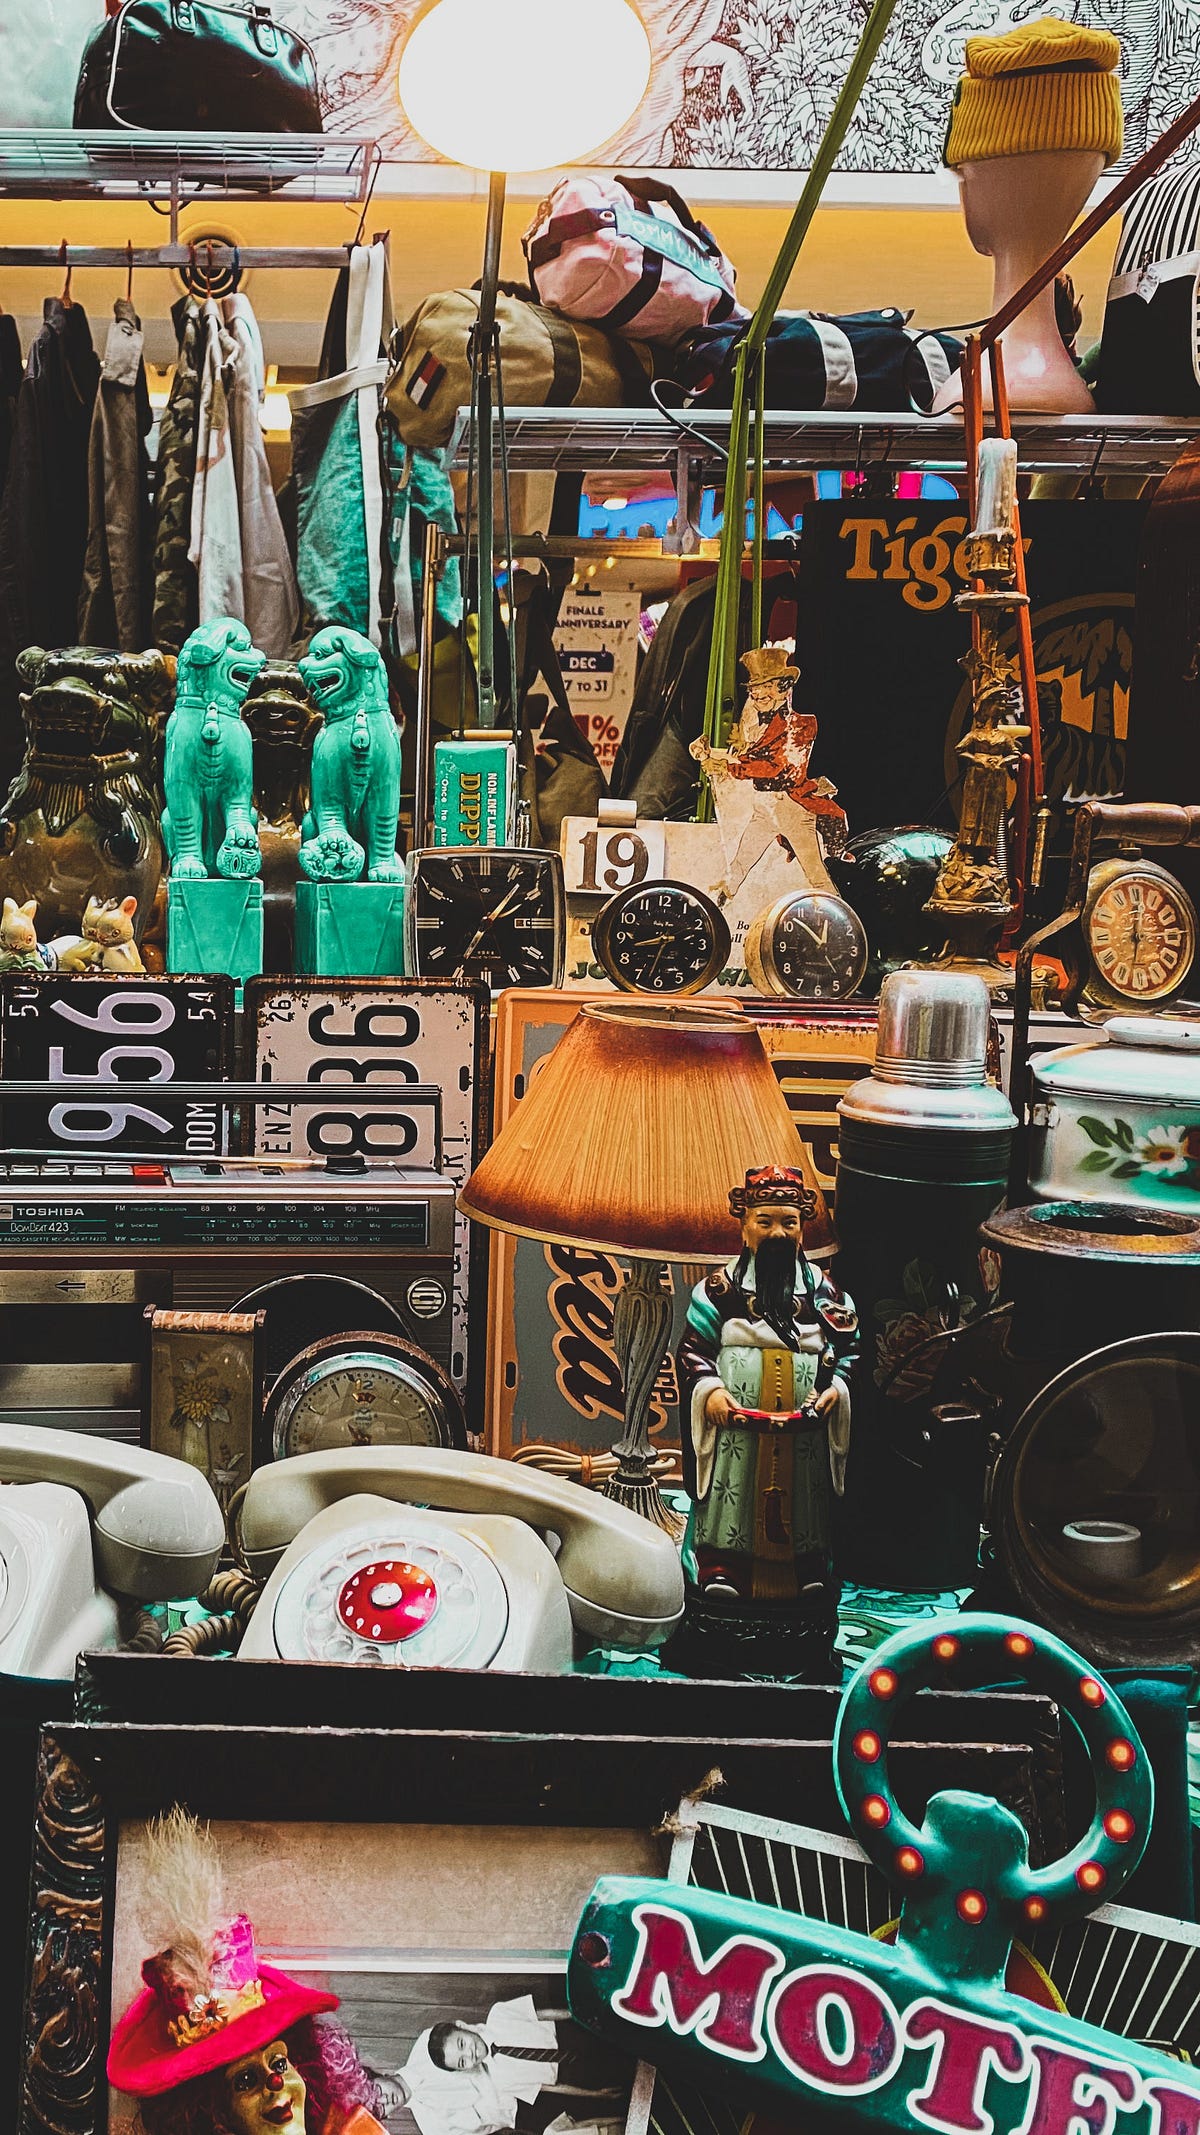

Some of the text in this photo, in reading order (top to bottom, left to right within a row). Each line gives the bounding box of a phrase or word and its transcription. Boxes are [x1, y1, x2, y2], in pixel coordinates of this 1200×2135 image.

[566, 605, 604, 616] FINALE
[568, 656, 597, 670] DEC
[576, 681, 591, 692] TO
[594, 679, 608, 692] 31
[576, 832, 650, 891] 19
[640, 899, 650, 910] 11
[658, 895, 672, 907] 12
[683, 903, 688, 914] 1
[797, 907, 804, 918] 11
[621, 912, 636, 924] 10
[694, 919, 703, 930] 2
[783, 921, 794, 932] 10
[846, 925, 854, 936] 2
[616, 931, 626, 944] 9
[698, 939, 707, 951] 3
[779, 941, 787, 953] 9
[850, 946, 858, 957] 3
[620, 952, 630, 965] 8
[690, 958, 701, 970] 4
[635, 968, 643, 980] 7
[783, 962, 791, 974] 8
[845, 966, 853, 977] 4
[653, 976, 663, 987] 6
[675, 972, 684, 984] 5
[796, 978, 804, 990] 7
[814, 985, 822, 997] 6
[832, 980, 840, 991] 5
[187, 992, 217, 1020] 54
[269, 999, 294, 1023] 26
[48, 992, 176, 1142] 956
[185, 1103, 217, 1151] DOM
[17, 1207, 85, 1216] TOSHIBA
[48, 1222, 69, 1232] 423
[366, 1566, 376, 1575] 5
[385, 1562, 393, 1571] 4
[403, 1565, 412, 1574] 3
[416, 1574, 426, 1584] 2
[345, 1590, 353, 1600] 7
[356, 1618, 364, 1629] 9
[372, 1624, 381, 1637] 0
